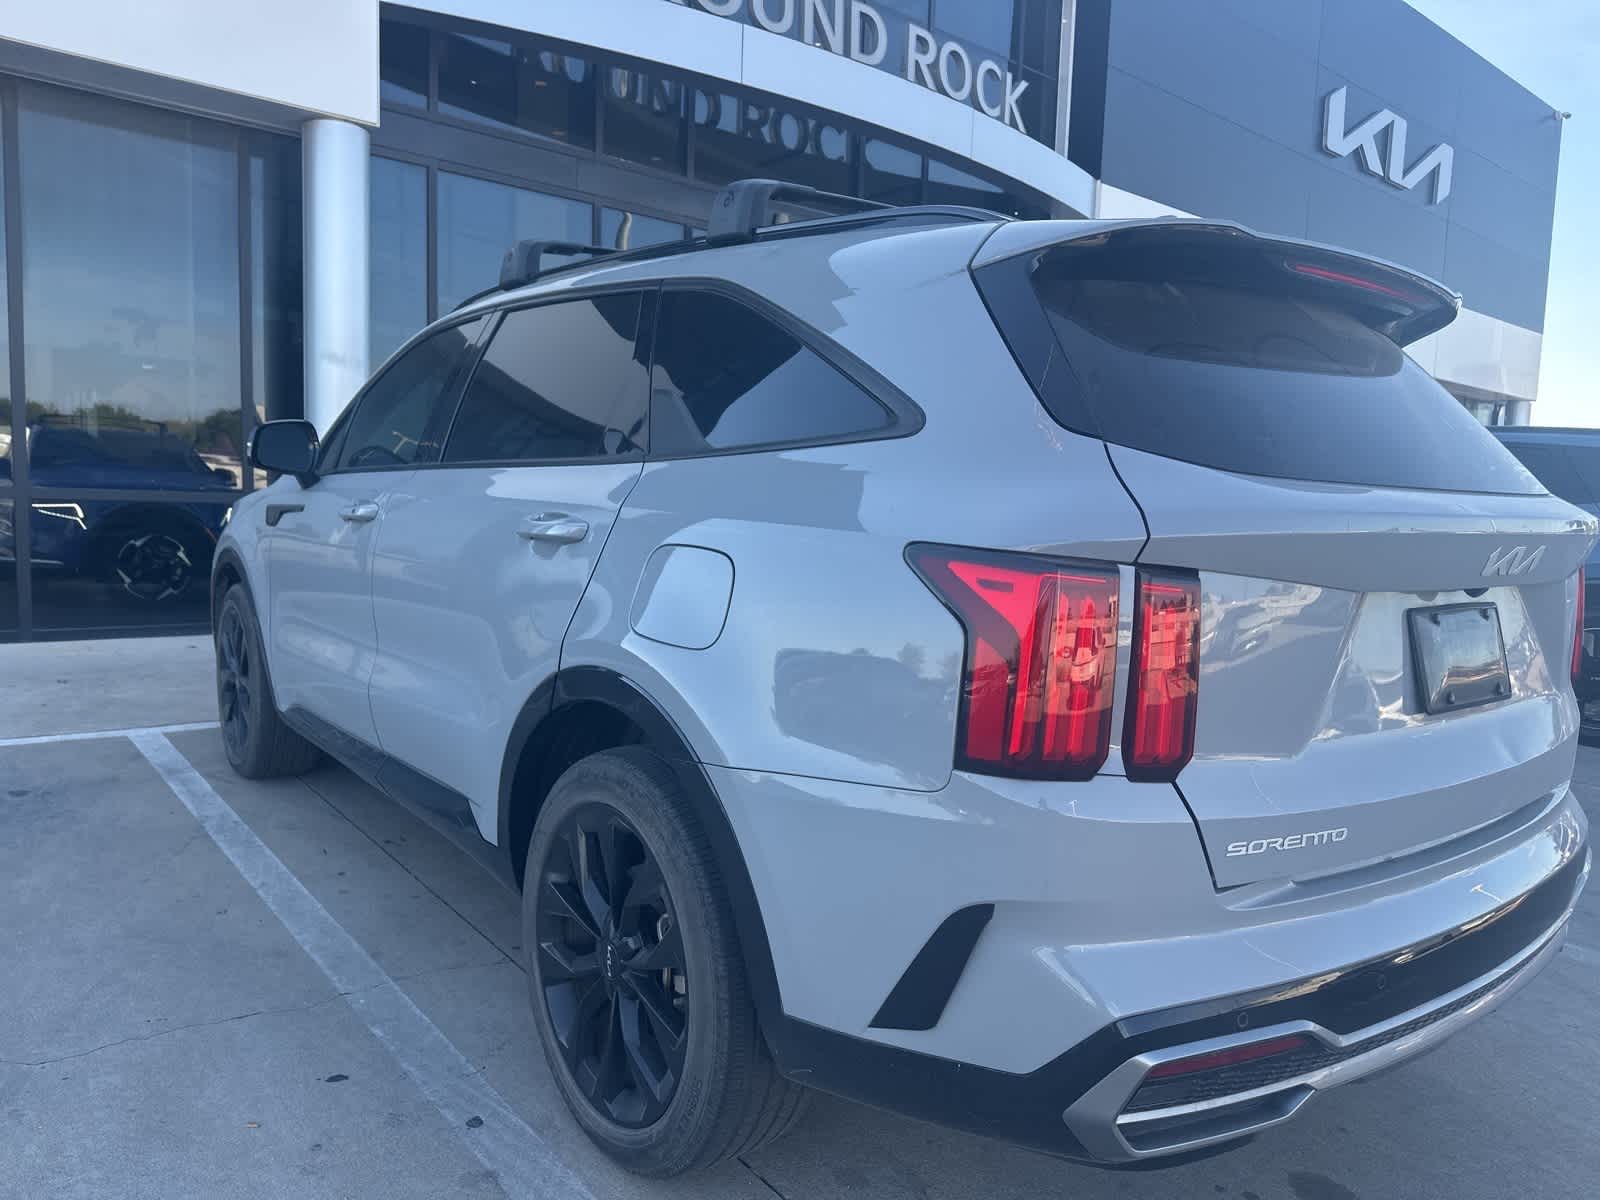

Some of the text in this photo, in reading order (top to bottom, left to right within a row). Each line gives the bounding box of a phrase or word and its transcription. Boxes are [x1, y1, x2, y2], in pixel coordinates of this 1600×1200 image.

[906, 22, 1030, 134] ROCK
[1323, 85, 1455, 205] KIA
[1480, 544, 1547, 577] KIA
[1226, 827, 1349, 857] SORENTO
